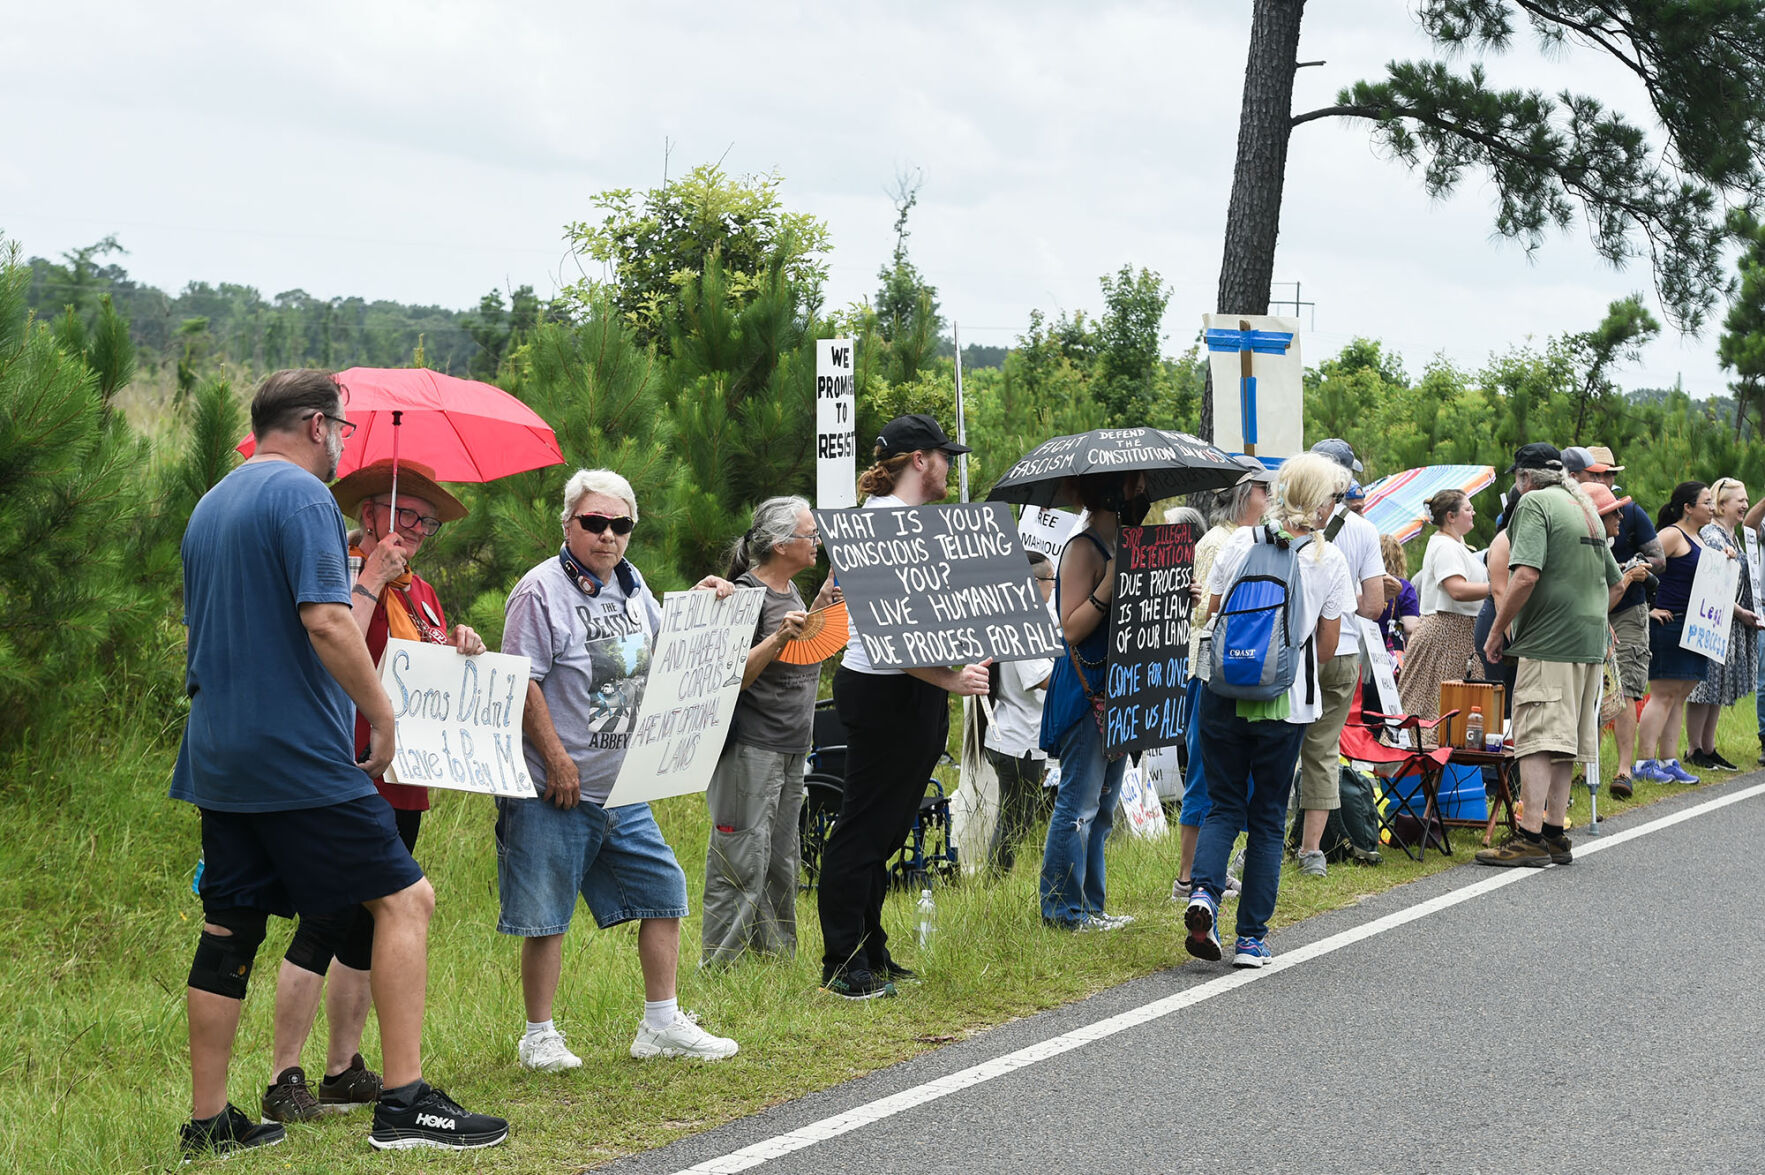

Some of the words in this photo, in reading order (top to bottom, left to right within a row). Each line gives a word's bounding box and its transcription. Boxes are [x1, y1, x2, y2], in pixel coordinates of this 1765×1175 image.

[831, 346, 849, 368] WE
[836, 402, 847, 424] TO
[819, 431, 855, 459] RESIST
[1033, 435, 1089, 456] FIGHT
[1099, 429, 1146, 440] DEFEND
[1116, 439, 1142, 448] THE
[1009, 452, 1076, 479] FASCISM
[1088, 447, 1176, 466] CONSTITUTION
[818, 512, 875, 540] WHAT
[891, 509, 924, 537] IS
[938, 506, 1000, 536] YOUR
[1037, 511, 1059, 528] REE
[1122, 527, 1144, 549] STOP
[1155, 524, 1193, 546] ILLEGAL
[832, 539, 930, 573] CONSCIOUS
[934, 531, 1013, 560] TELLING
[895, 561, 951, 595] YOU?
[1118, 571, 1143, 599] DUE
[1150, 566, 1192, 597] PROCESS
[601, 602, 618, 613] THE
[662, 596, 686, 634] THE
[684, 593, 708, 631] BILL
[724, 590, 762, 627] RIGHTS
[868, 596, 918, 627] LIVE
[928, 577, 1040, 623] HUMANITY!
[1118, 603, 1132, 625] IS
[1139, 597, 1161, 623] THE
[1164, 594, 1191, 620] LAW
[862, 632, 903, 665] DUE
[902, 627, 985, 665] PROCESS
[985, 624, 1027, 658] FOR
[1024, 621, 1065, 655] ALL
[1116, 626, 1132, 654] OF
[1137, 624, 1160, 650] OUR
[1229, 648, 1256, 657] COAST
[658, 638, 687, 674] AND
[678, 661, 724, 701] CORPUS
[1108, 662, 1142, 699] COME
[1147, 661, 1162, 688] FOR
[1166, 657, 1189, 689] ONE
[630, 713, 662, 749] ARE
[656, 706, 681, 742] NOT
[677, 697, 721, 736] OPTIONAL
[1106, 704, 1140, 749] FACE
[1145, 704, 1159, 730] US
[1160, 695, 1187, 740] ALL!
[588, 732, 632, 750] ABBEY
[656, 734, 701, 776] LAWS
[460, 727, 497, 793] Pay
[493, 732, 532, 793] Me
[415, 1113, 456, 1130] HOKA
